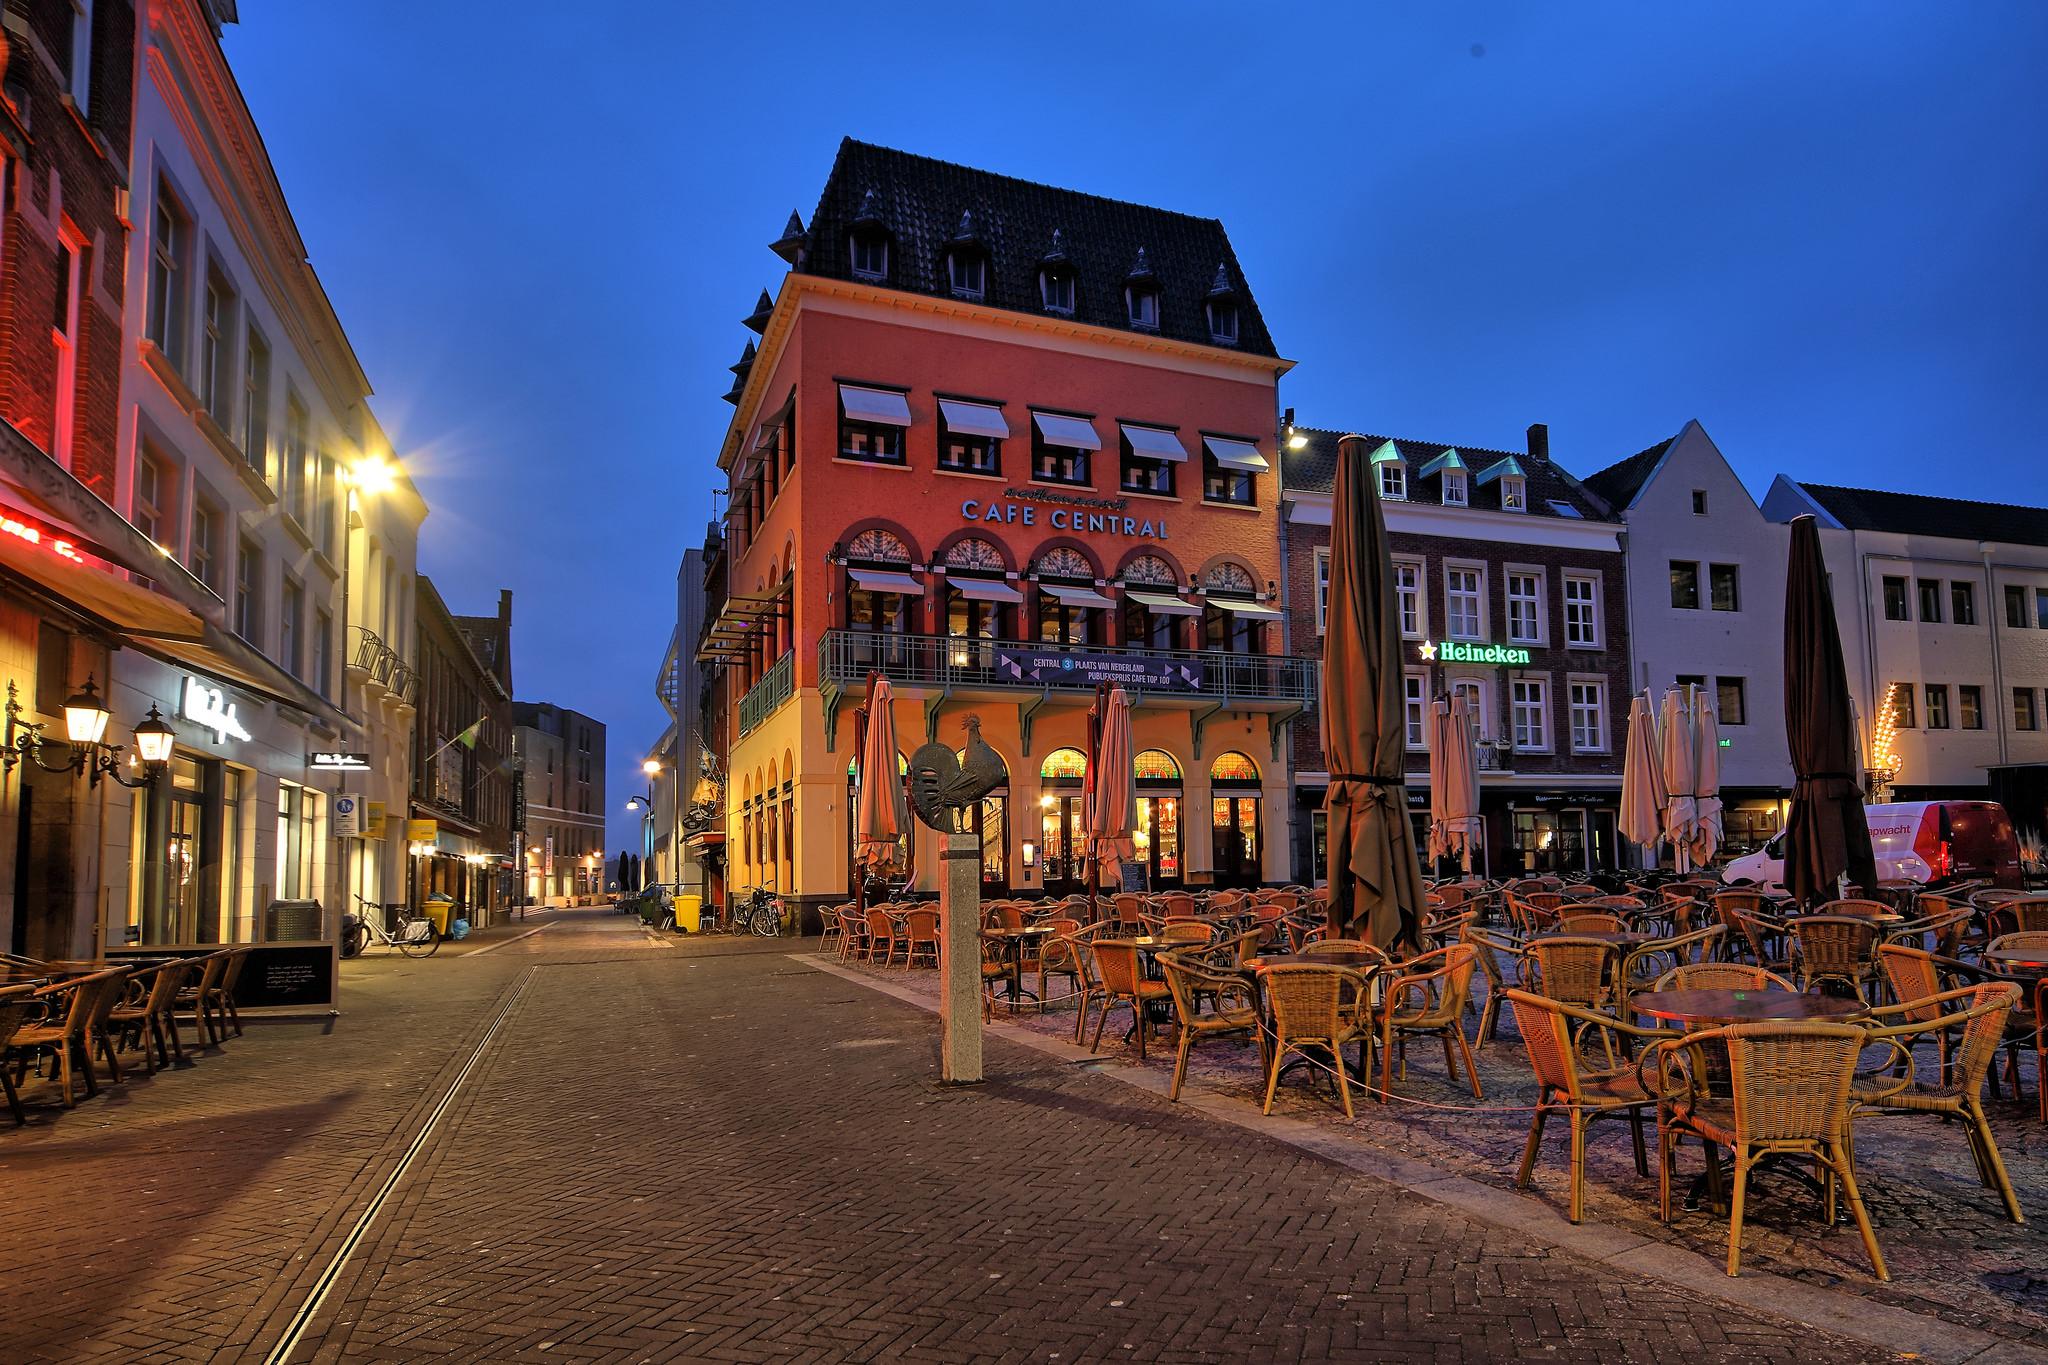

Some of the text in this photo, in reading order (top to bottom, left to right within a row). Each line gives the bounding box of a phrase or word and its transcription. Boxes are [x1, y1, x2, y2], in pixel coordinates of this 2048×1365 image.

[961, 499, 1169, 539] CAFE CENTRAL
[1439, 642, 1531, 664] Heineken
[1033, 658, 1061, 668] CENTRAL
[1074, 660, 1097, 670] PLAATS
[1097, 662, 1110, 671] VAN
[1110, 663, 1145, 673] NEDERLAND
[1131, 674, 1146, 683] CAFE
[1147, 676, 1158, 684] TOP
[1159, 676, 1170, 685] 100
[1868, 824, 1911, 838] apwacht
